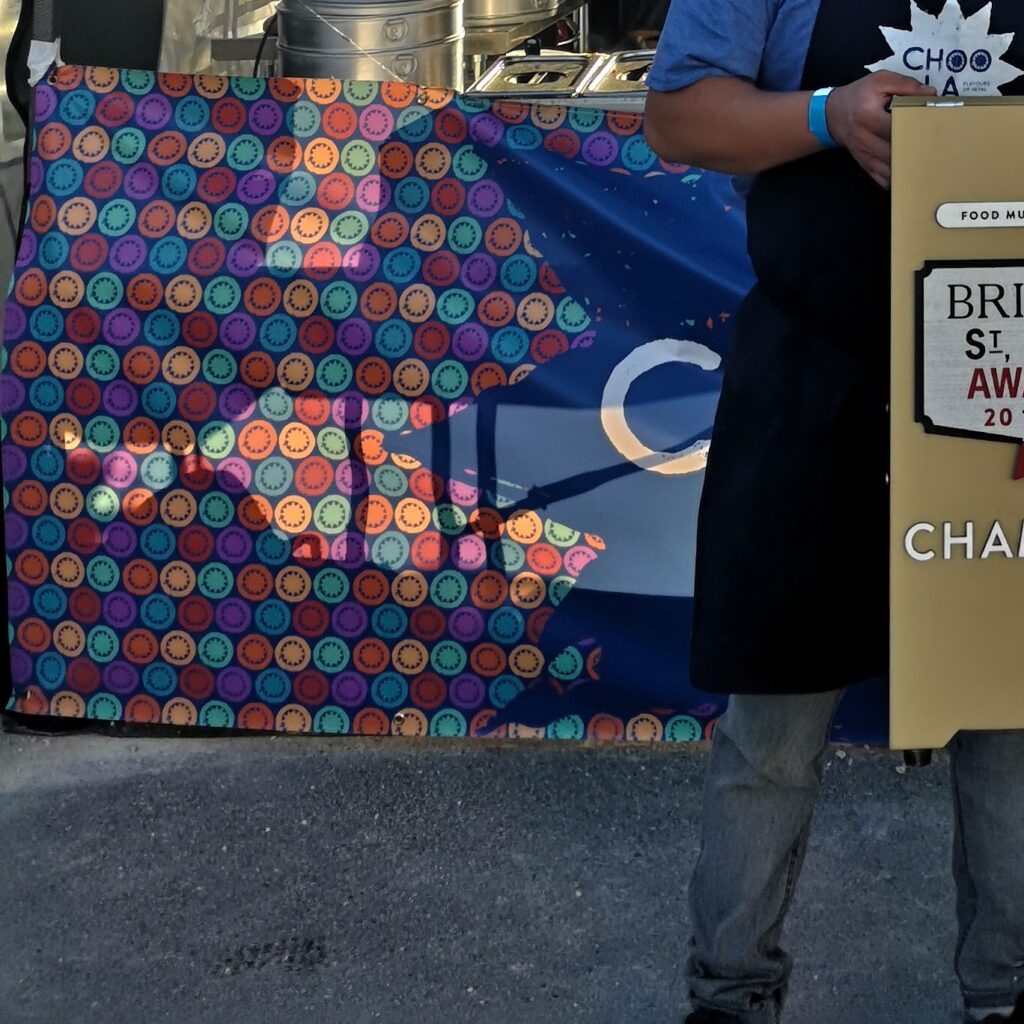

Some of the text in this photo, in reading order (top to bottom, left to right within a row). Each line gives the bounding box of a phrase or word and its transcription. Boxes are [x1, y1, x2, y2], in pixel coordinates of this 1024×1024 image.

[903, 47, 992, 73] CHOO
[961, 211, 1000, 221] FOOD
[984, 408, 1012, 426] 20
